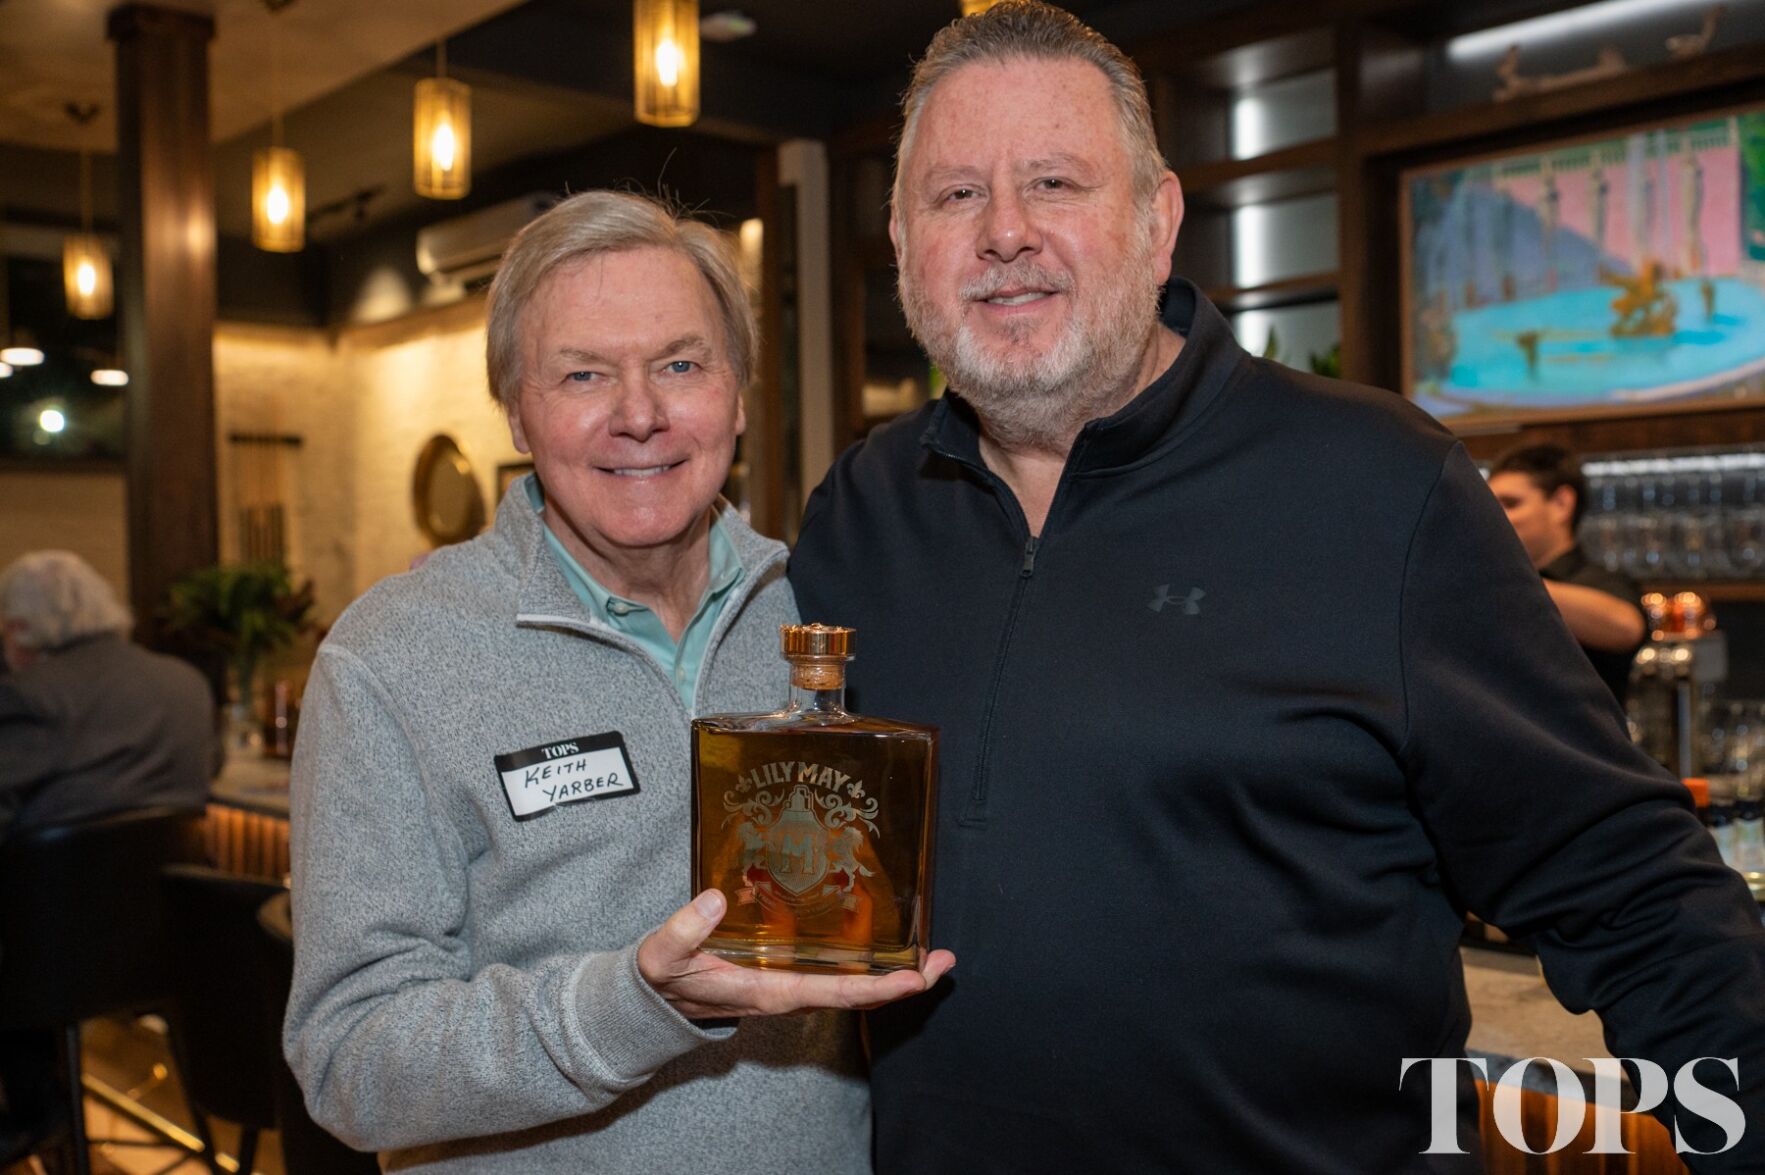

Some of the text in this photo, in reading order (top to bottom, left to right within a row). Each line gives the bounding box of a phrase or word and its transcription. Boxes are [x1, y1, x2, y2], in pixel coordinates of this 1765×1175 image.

[541, 742, 579, 759] TOPS
[524, 759, 586, 788] KEITH
[543, 772, 624, 801] YARBER
[750, 761, 851, 792] LILY MAY
